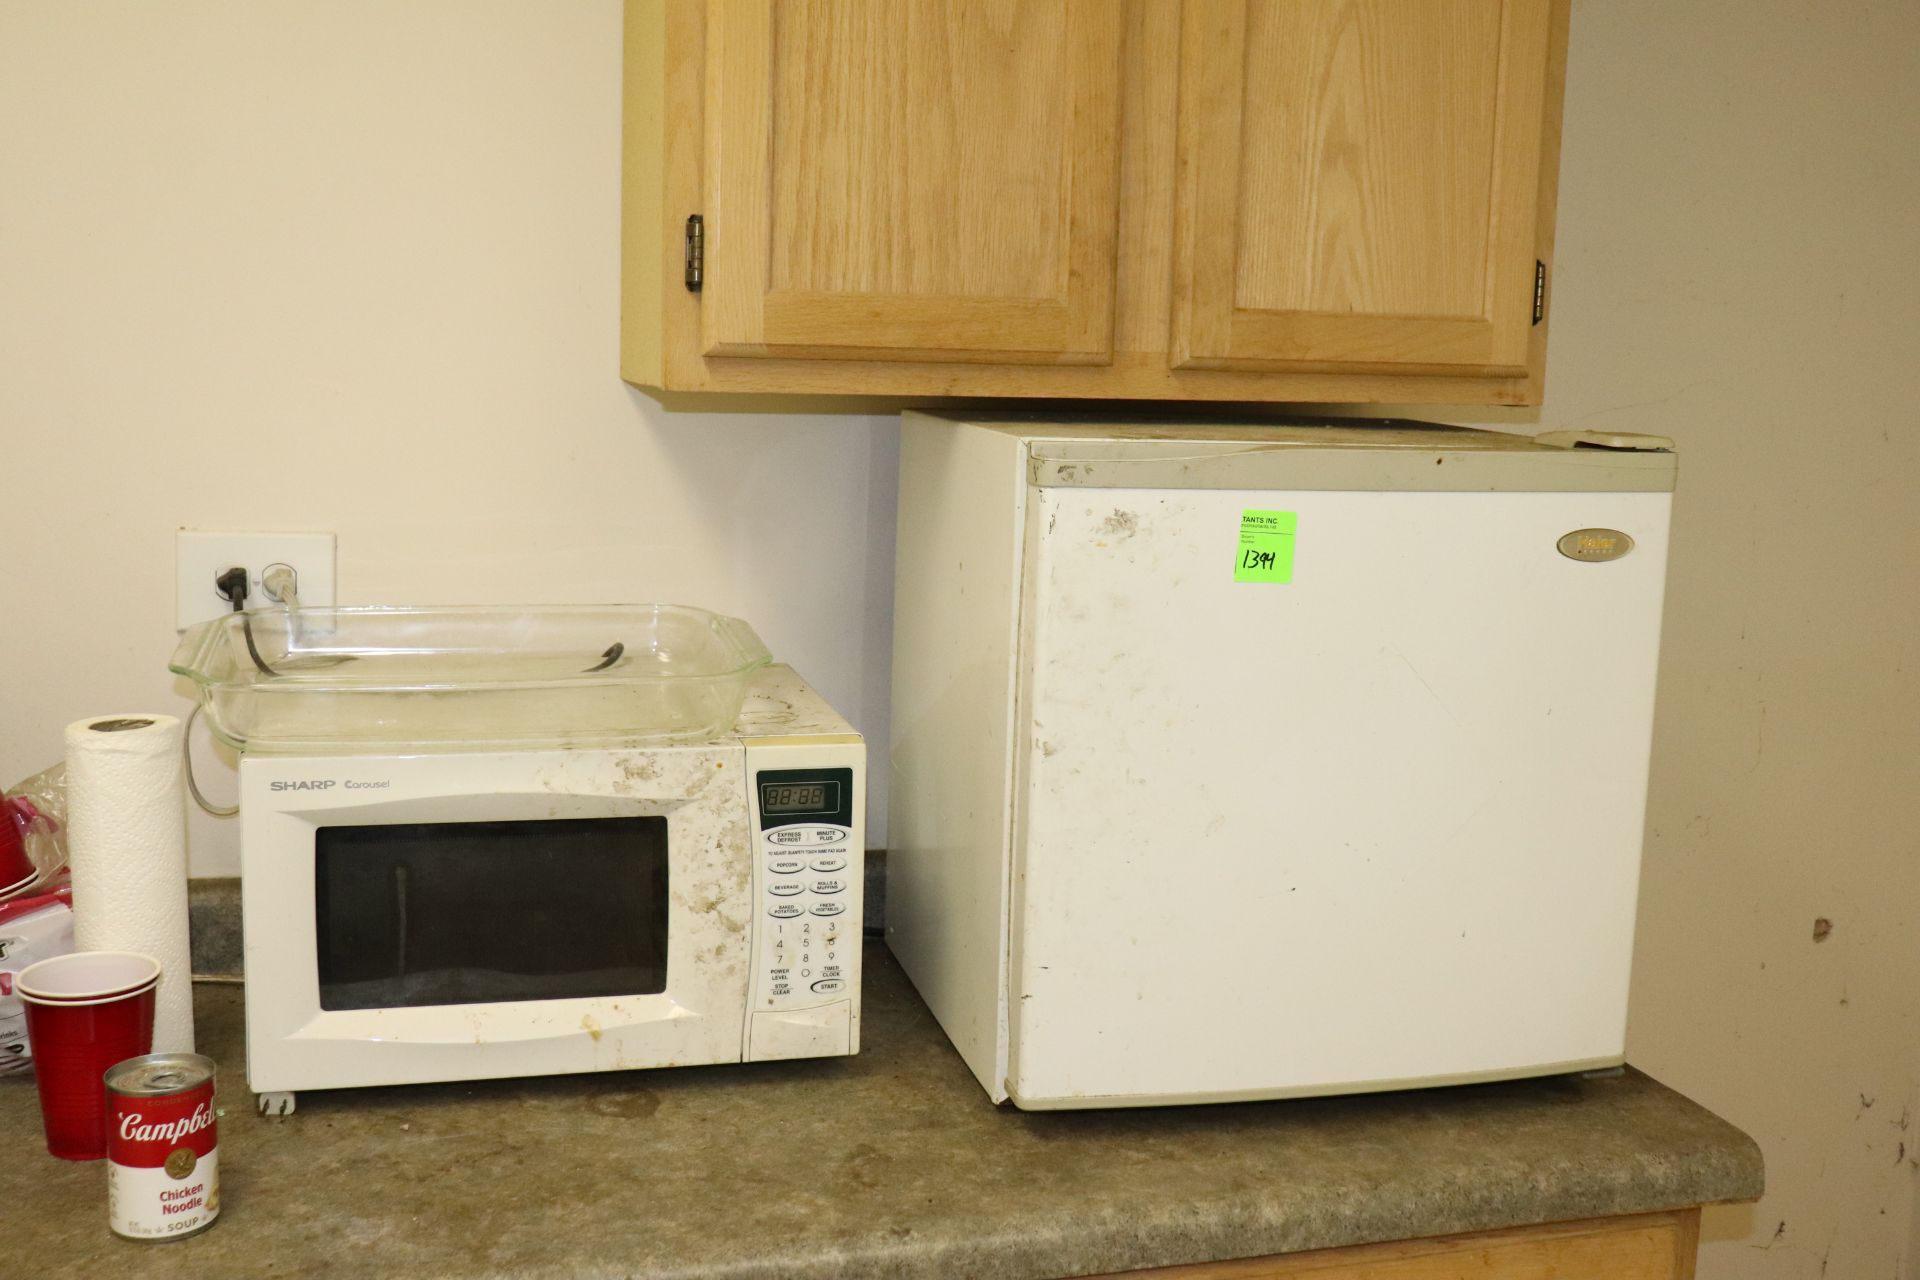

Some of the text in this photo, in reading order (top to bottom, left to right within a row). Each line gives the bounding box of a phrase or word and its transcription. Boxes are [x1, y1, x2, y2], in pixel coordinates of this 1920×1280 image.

[1242, 516, 1265, 524] TANTS
[270, 779, 390, 791] SHARP Carousel
[803, 923, 810, 933] 2
[829, 922, 835, 932] 3
[776, 940, 783, 949] 4
[802, 938, 810, 948] 5
[777, 955, 783, 964] 7
[802, 953, 809, 962] 8
[828, 952, 835, 961] 9
[160, 1183, 204, 1202] Chicken
[162, 1197, 203, 1216] Noodle
[167, 1216, 199, 1233] SOUP
